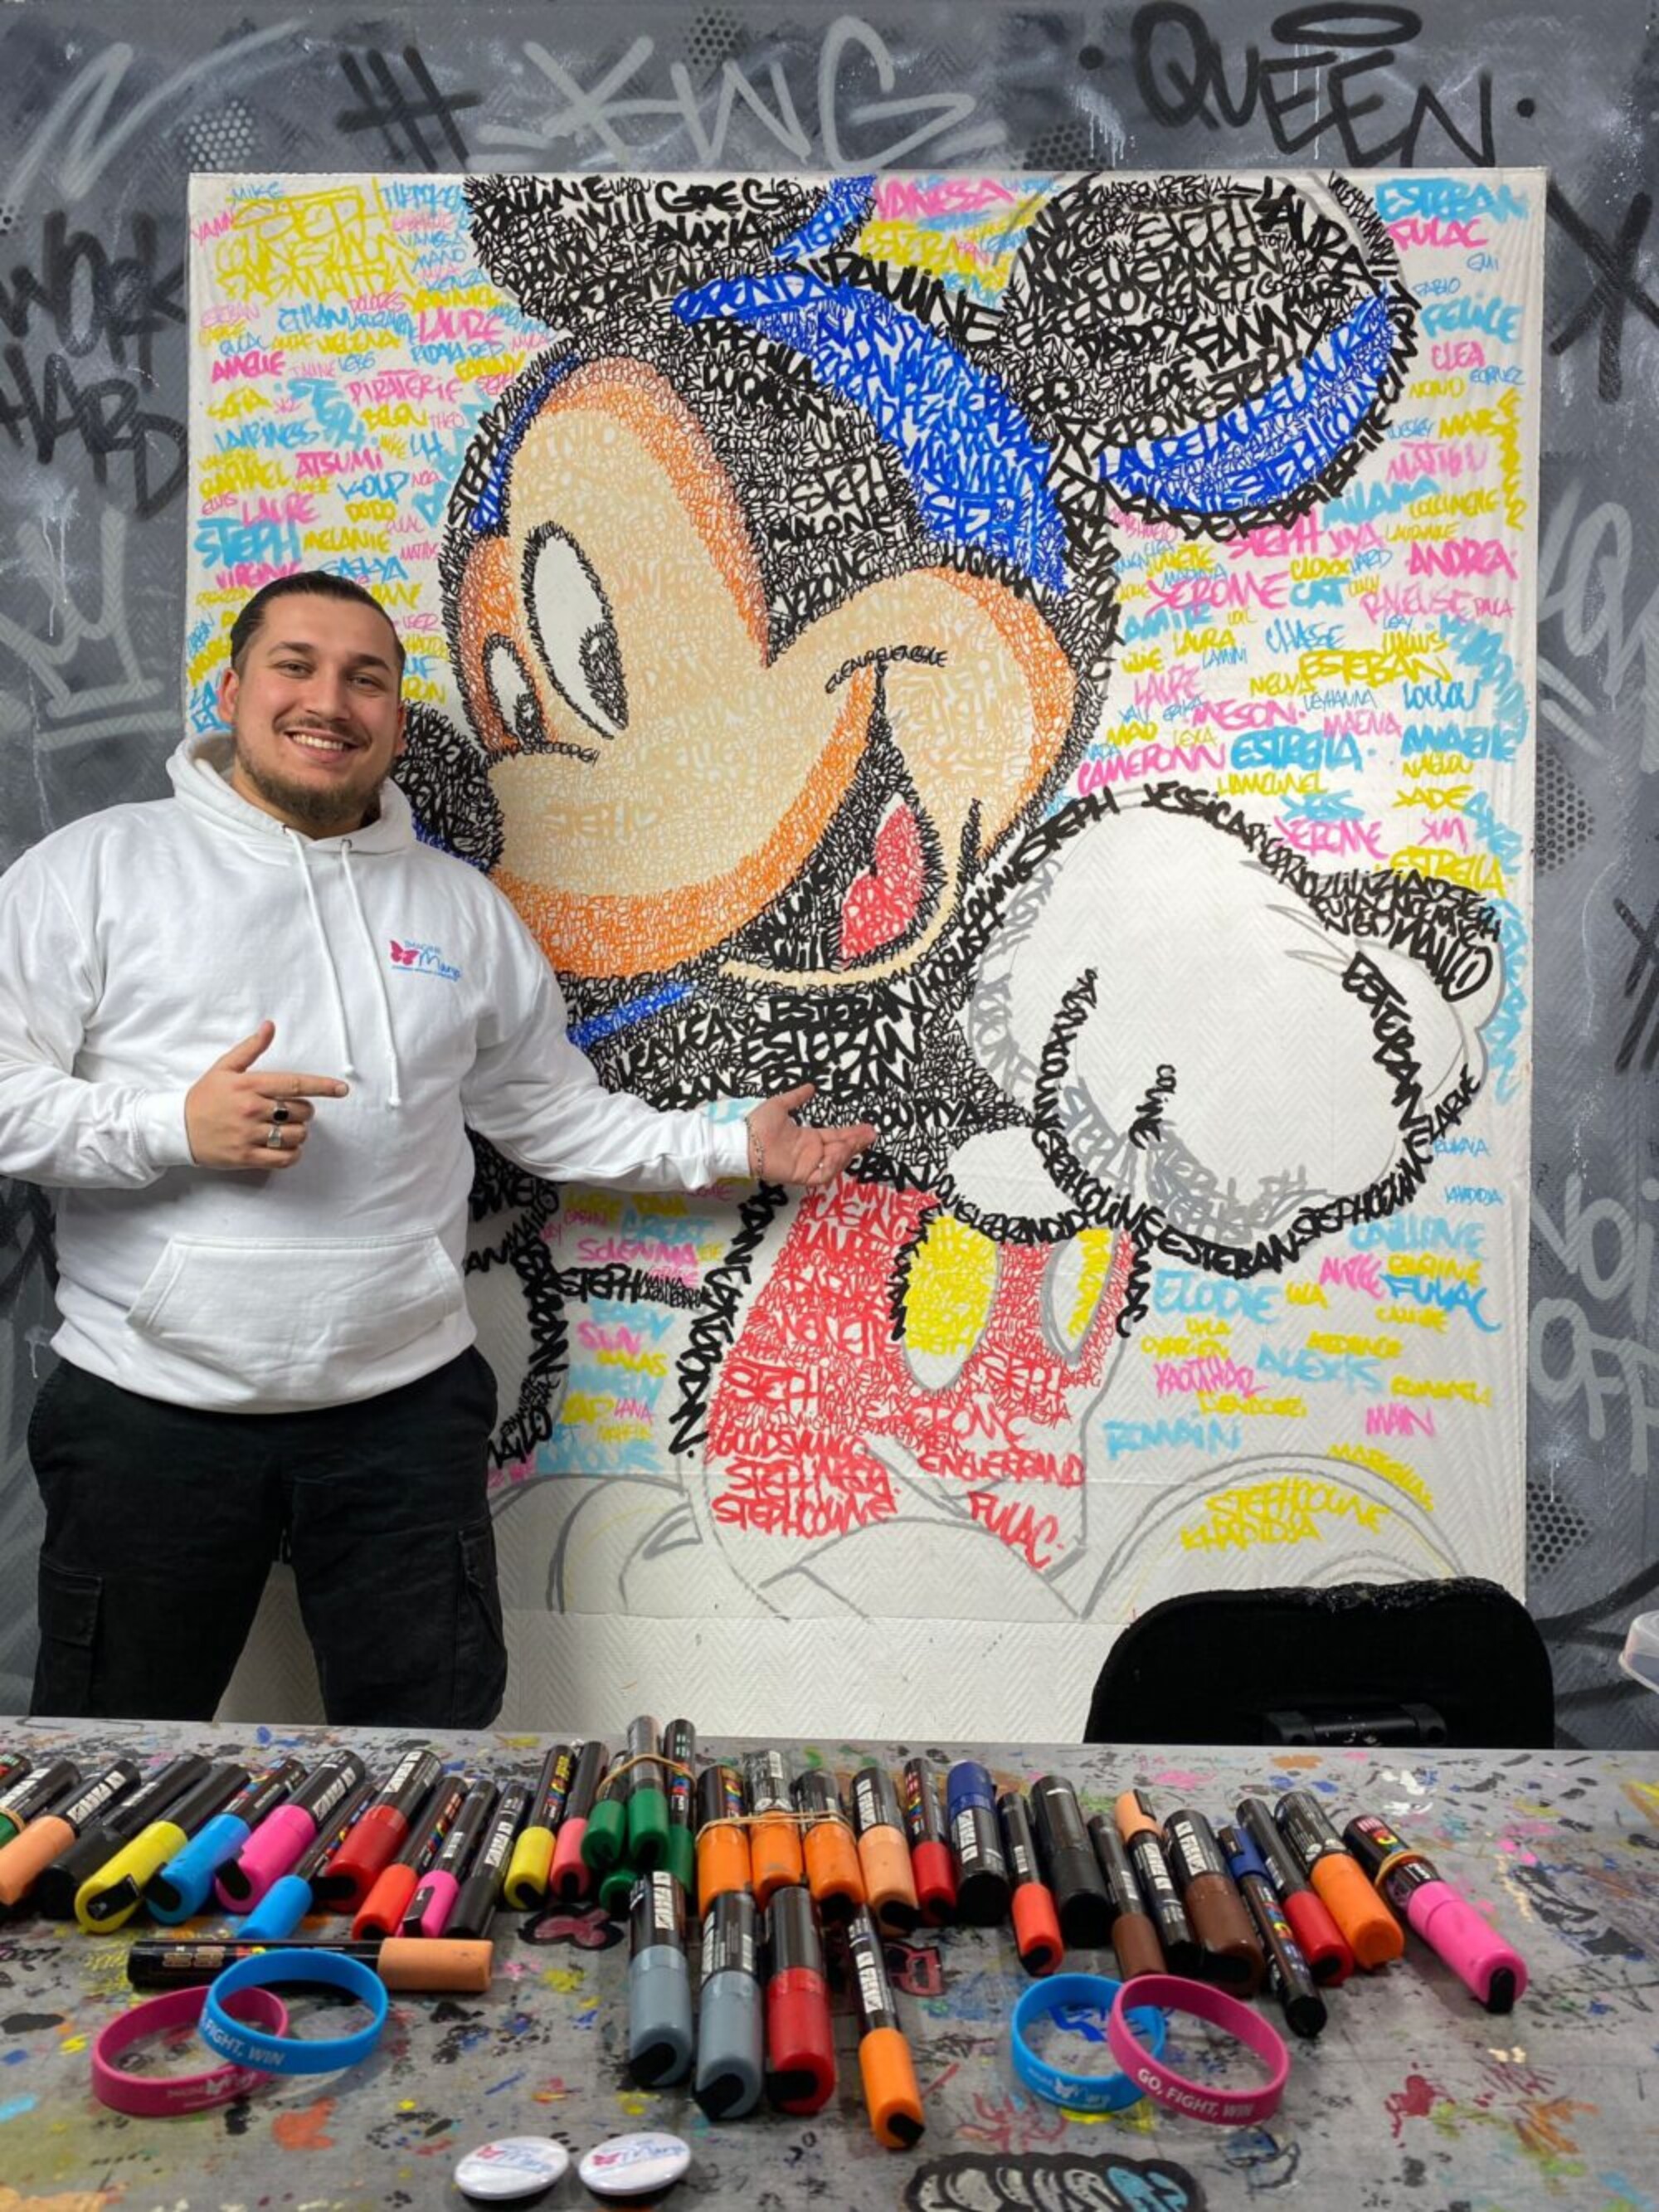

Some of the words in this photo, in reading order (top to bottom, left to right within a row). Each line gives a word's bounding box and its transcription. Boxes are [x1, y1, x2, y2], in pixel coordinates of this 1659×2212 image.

[1130, 5, 1495, 168] QUEEN
[1375, 178, 1529, 223] ESTEBAN
[211, 351, 285, 382] AMELIE
[346, 369, 464, 404] PIRATERIE
[193, 516, 304, 569] STEPH
[1408, 538, 1519, 580] ANDREA
[1145, 570, 1290, 616] JEROME
[1173, 626, 1236, 656] LAURA
[1299, 648, 1453, 688] ESTEBAN
[741, 1021, 925, 1072] ESTEBAN
[1157, 1223, 1301, 1282] ESTEBAN
[1379, 1272, 1503, 1333] FULAC
[248, 2045, 286, 2068] WIN
[1137, 2067, 1164, 2096] GO,
[1165, 2085, 1219, 2118] FIGHT,
[1223, 2102, 1255, 2119] WIN
